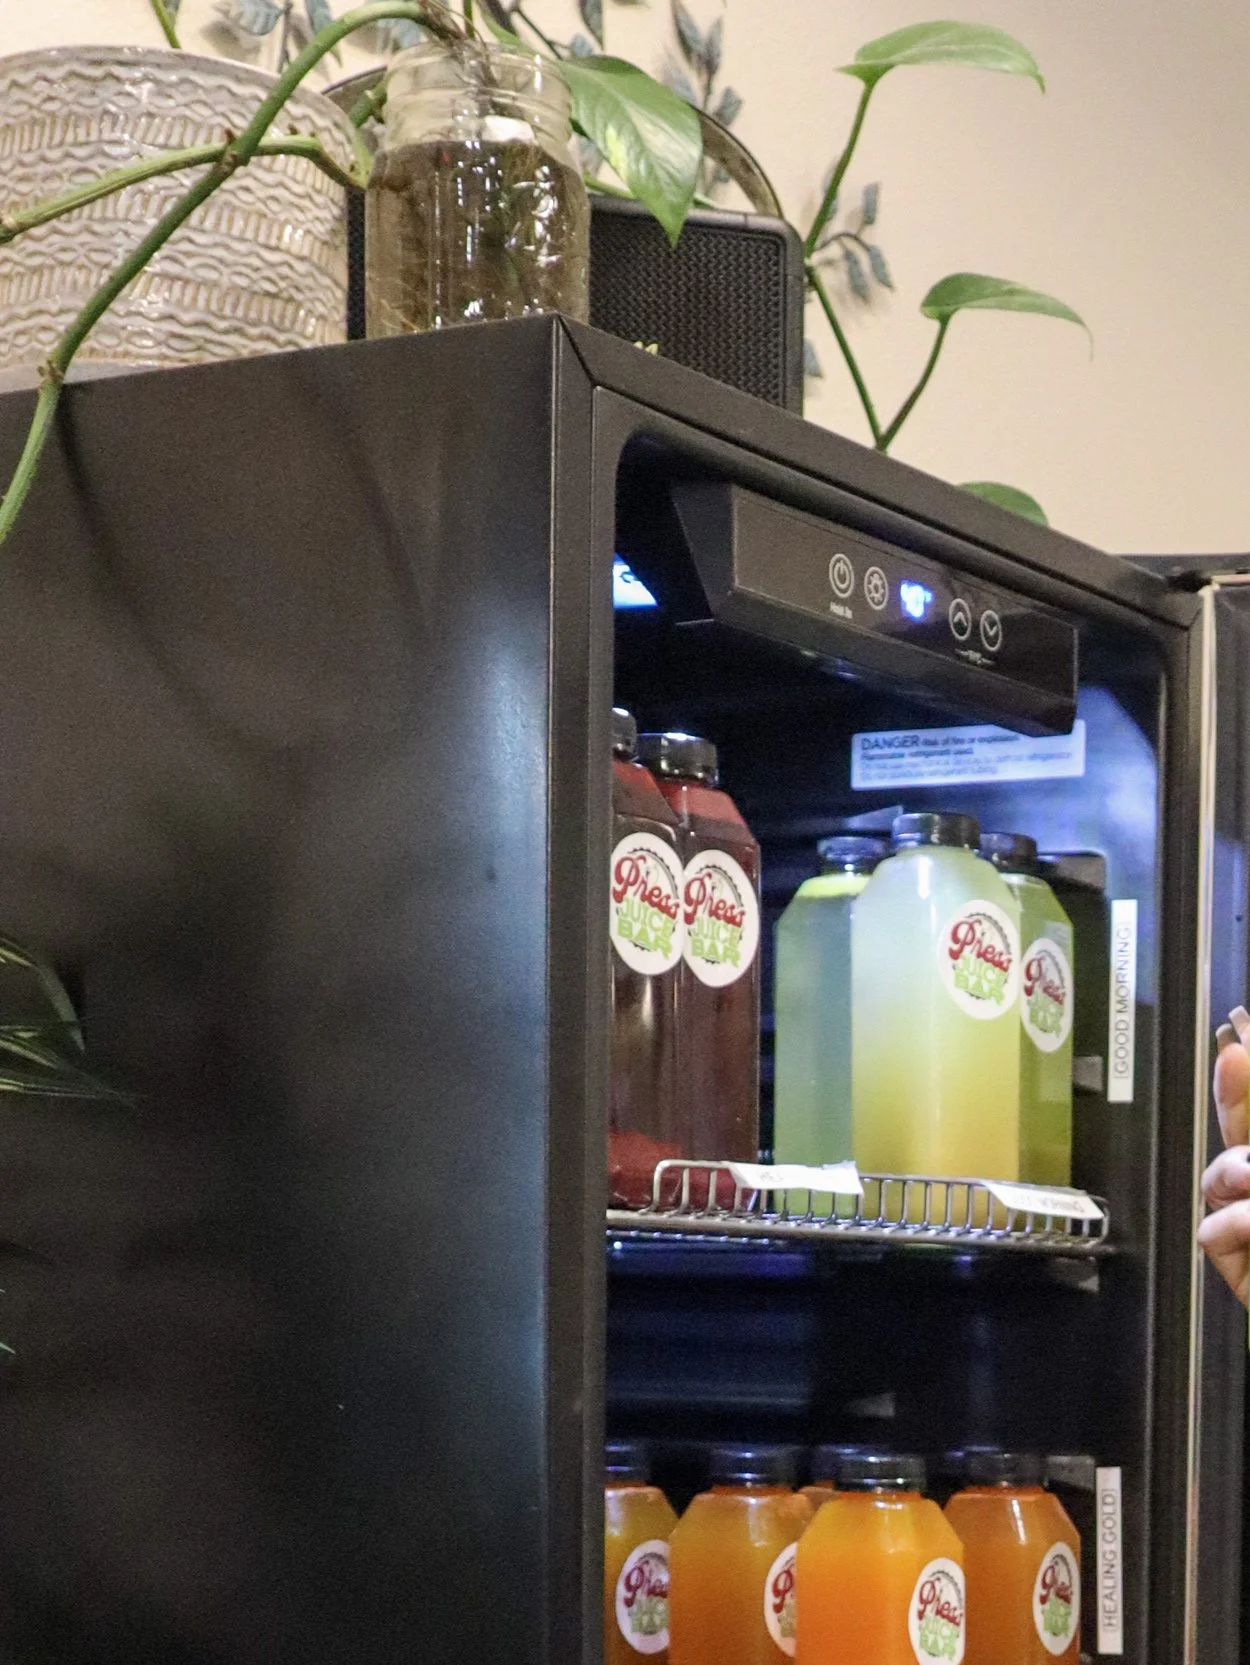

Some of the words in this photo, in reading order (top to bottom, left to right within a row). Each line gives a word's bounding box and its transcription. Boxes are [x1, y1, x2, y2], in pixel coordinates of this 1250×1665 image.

[861, 734, 920, 750] DANGER
[612, 854, 680, 920] Press
[684, 871, 745, 928] Press
[617, 917, 673, 960] BAR
[620, 899, 675, 934] JUICE
[694, 915, 742, 947] JUICE
[691, 937, 741, 968] BAR
[948, 918, 1012, 972] Press
[1115, 926, 1131, 1014] MORNING
[955, 967, 1005, 1007] BAR
[1114, 1018, 1129, 1074] GOOD
[1102, 1493, 1117, 1544] GOLD
[1103, 1551, 1118, 1628] HEALING
